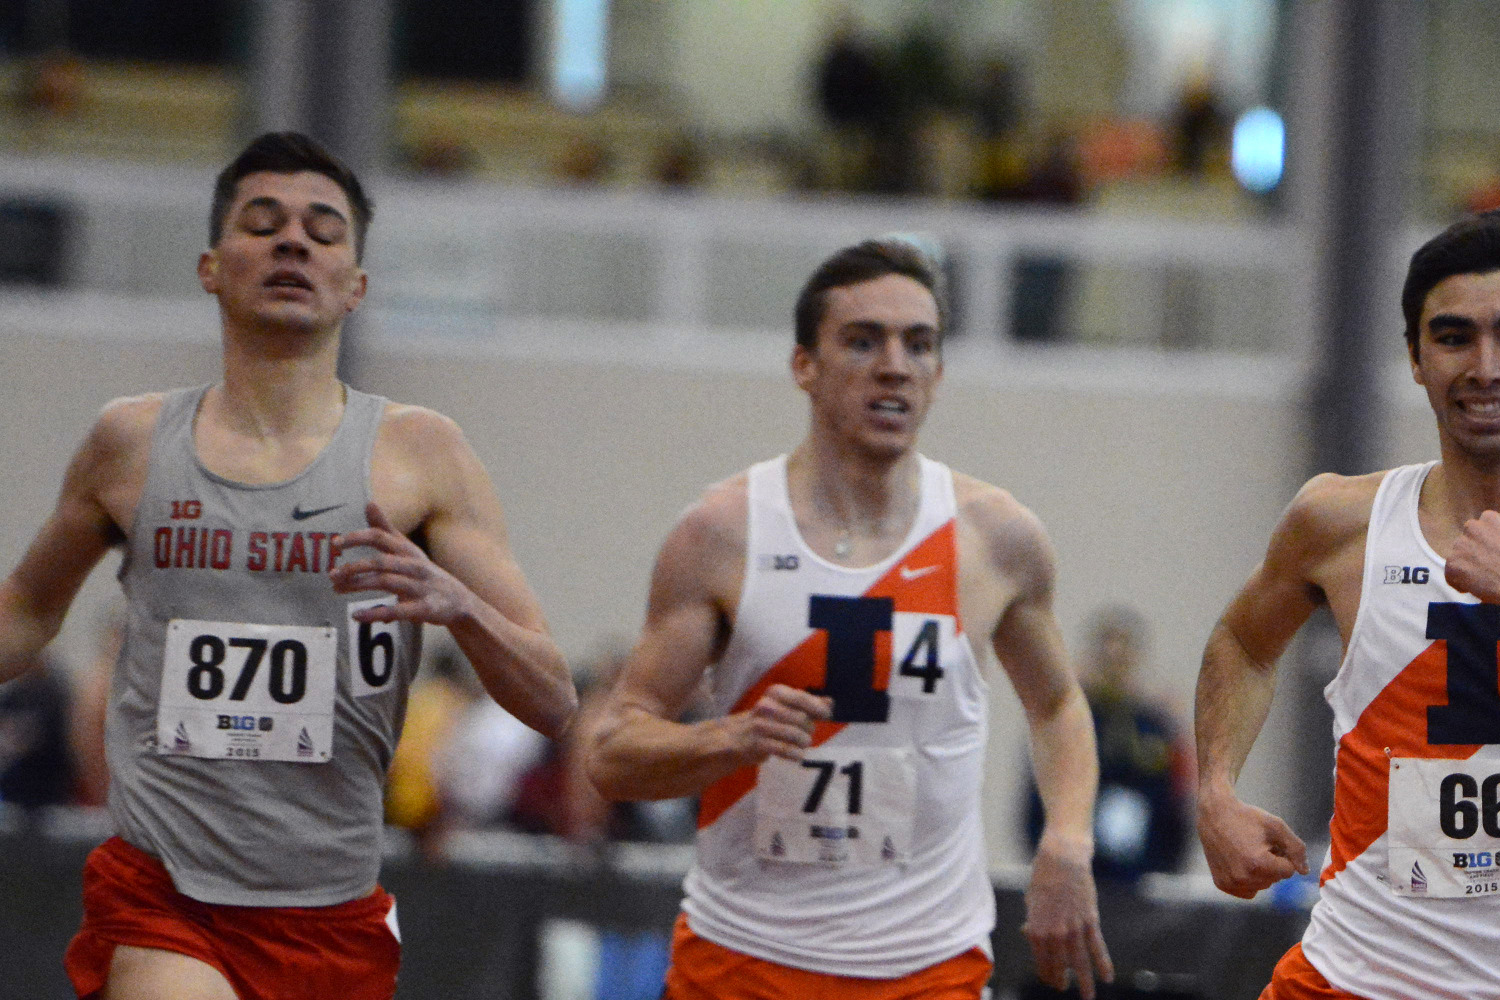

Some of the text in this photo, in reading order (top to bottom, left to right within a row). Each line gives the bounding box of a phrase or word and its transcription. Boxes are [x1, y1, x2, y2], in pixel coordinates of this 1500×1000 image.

[154, 527, 234, 571] OHIO
[187, 634, 308, 704] 870
[357, 604, 395, 687] 6
[900, 619, 944, 693] 4
[802, 760, 863, 815] 71
[1466, 882, 1498, 894] 2015
